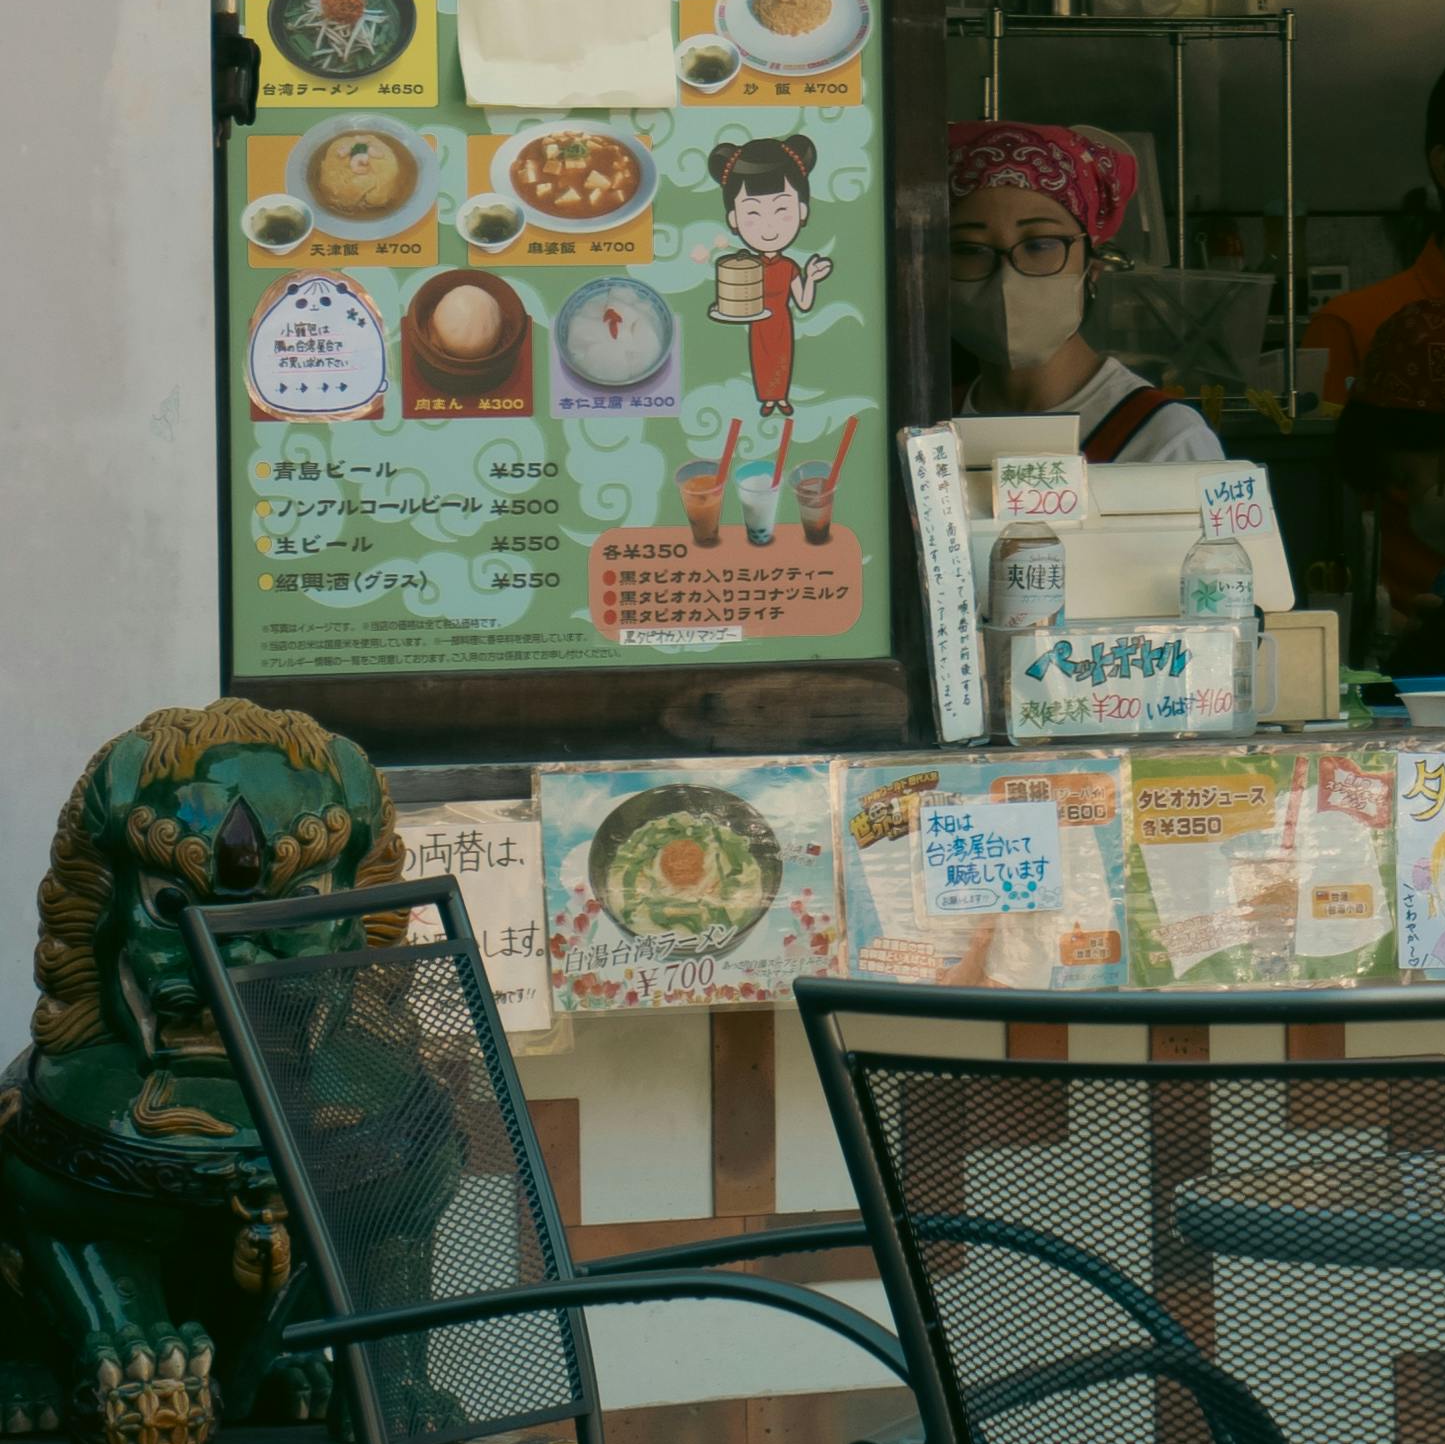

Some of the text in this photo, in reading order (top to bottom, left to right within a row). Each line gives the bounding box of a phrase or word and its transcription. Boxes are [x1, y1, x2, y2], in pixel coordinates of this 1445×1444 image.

[262, 83, 424, 97] 台湾ラーメン ¥650
[803, 82, 849, 95] ¥700
[309, 240, 423, 258] 天津飯 ¥700
[527, 239, 636, 257] 麻婆飯 ¥700
[414, 397, 524, 411] 肉まん ¥300
[559, 395, 675, 411] 杏仁豆腐 ¥300
[273, 460, 559, 481] 青島ビール ¥550
[1000, 462, 1069, 488] 爽健美茶
[1007, 489, 1078, 516] ¥200
[1204, 476, 1256, 506] いろはす
[277, 494, 559, 518] ノンアルコールビール ¥500
[1209, 503, 1264, 537] ¥160
[274, 535, 560, 555] 生ビール ¥550
[602, 544, 688, 560] 各¥350
[275, 571, 561, 593] 紹興酒（グラス） ¥550
[619, 568, 835, 586] 黒タピオカ入りミルクティー
[619, 606, 785, 625] 黒タピオカ入りライチ
[1025, 634, 1193, 687] ペットボトル
[1092, 692, 1142, 723] ¥200
[1196, 687, 1233, 714] ¥160
[1138, 786, 1267, 811] タピオカジュース
[926, 810, 974, 837] 本日は
[1142, 815, 1222, 837] 各¥350
[926, 833, 1032, 867] 台湾屋台にて
[945, 856, 1049, 887] 販売しています
[564, 924, 739, 975] 白湯台湾ラーメン
[636, 958, 716, 998] ¥700
